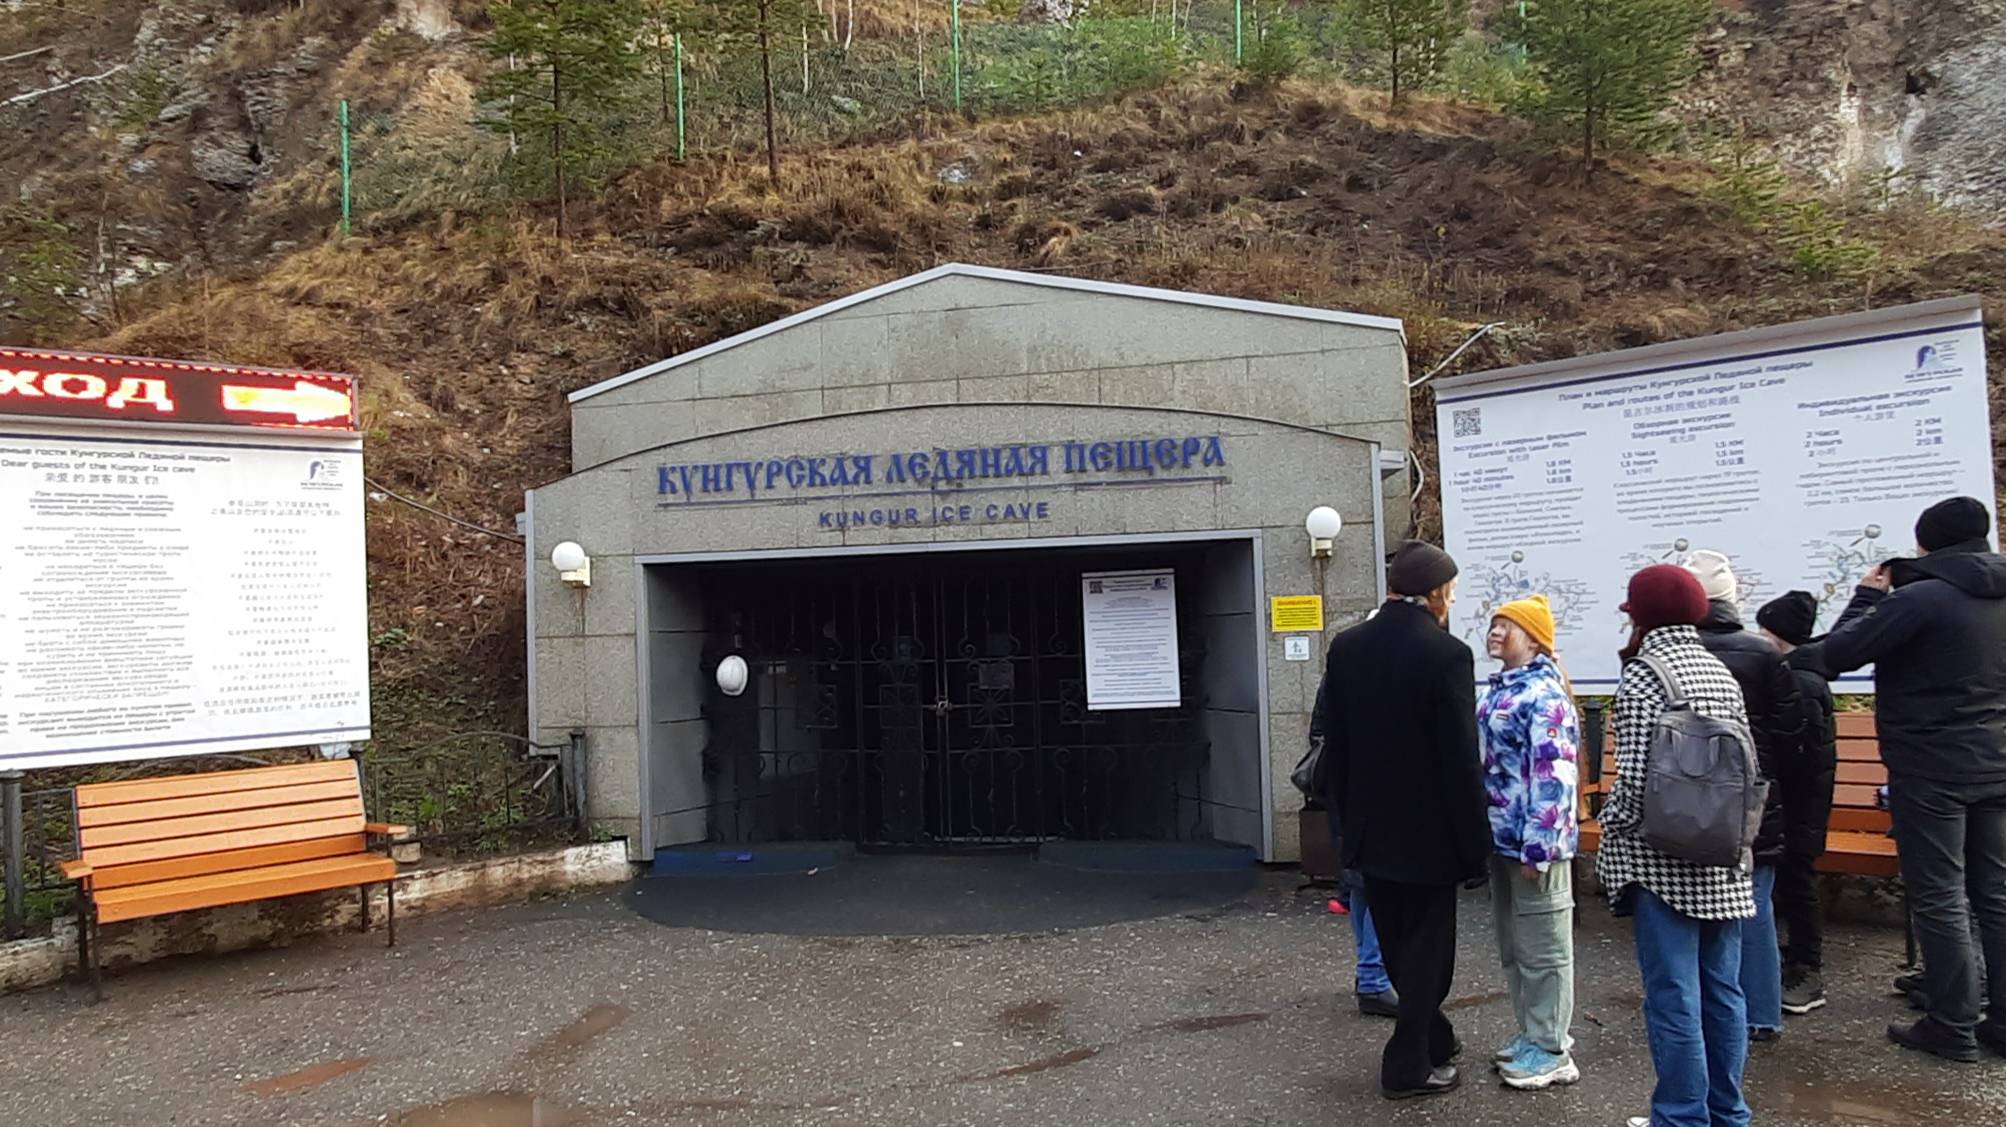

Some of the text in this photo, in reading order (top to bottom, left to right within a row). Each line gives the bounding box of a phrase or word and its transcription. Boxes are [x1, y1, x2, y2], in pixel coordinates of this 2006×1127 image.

[1650, 374, 1711, 390] Кунгурской
[1583, 377, 1785, 410] Plan and routes of the Kungur Ice Cave
[70, 449, 135, 460] Кунгурской
[32, 461, 70, 469] guests
[111, 464, 149, 473] Kungur
[658, 435, 1226, 502] КУНГУРСКАЯ ЛЕДЯНАЯ ПЕЩЕРА
[819, 502, 1049, 527] KUNGUR ICE CAVE
